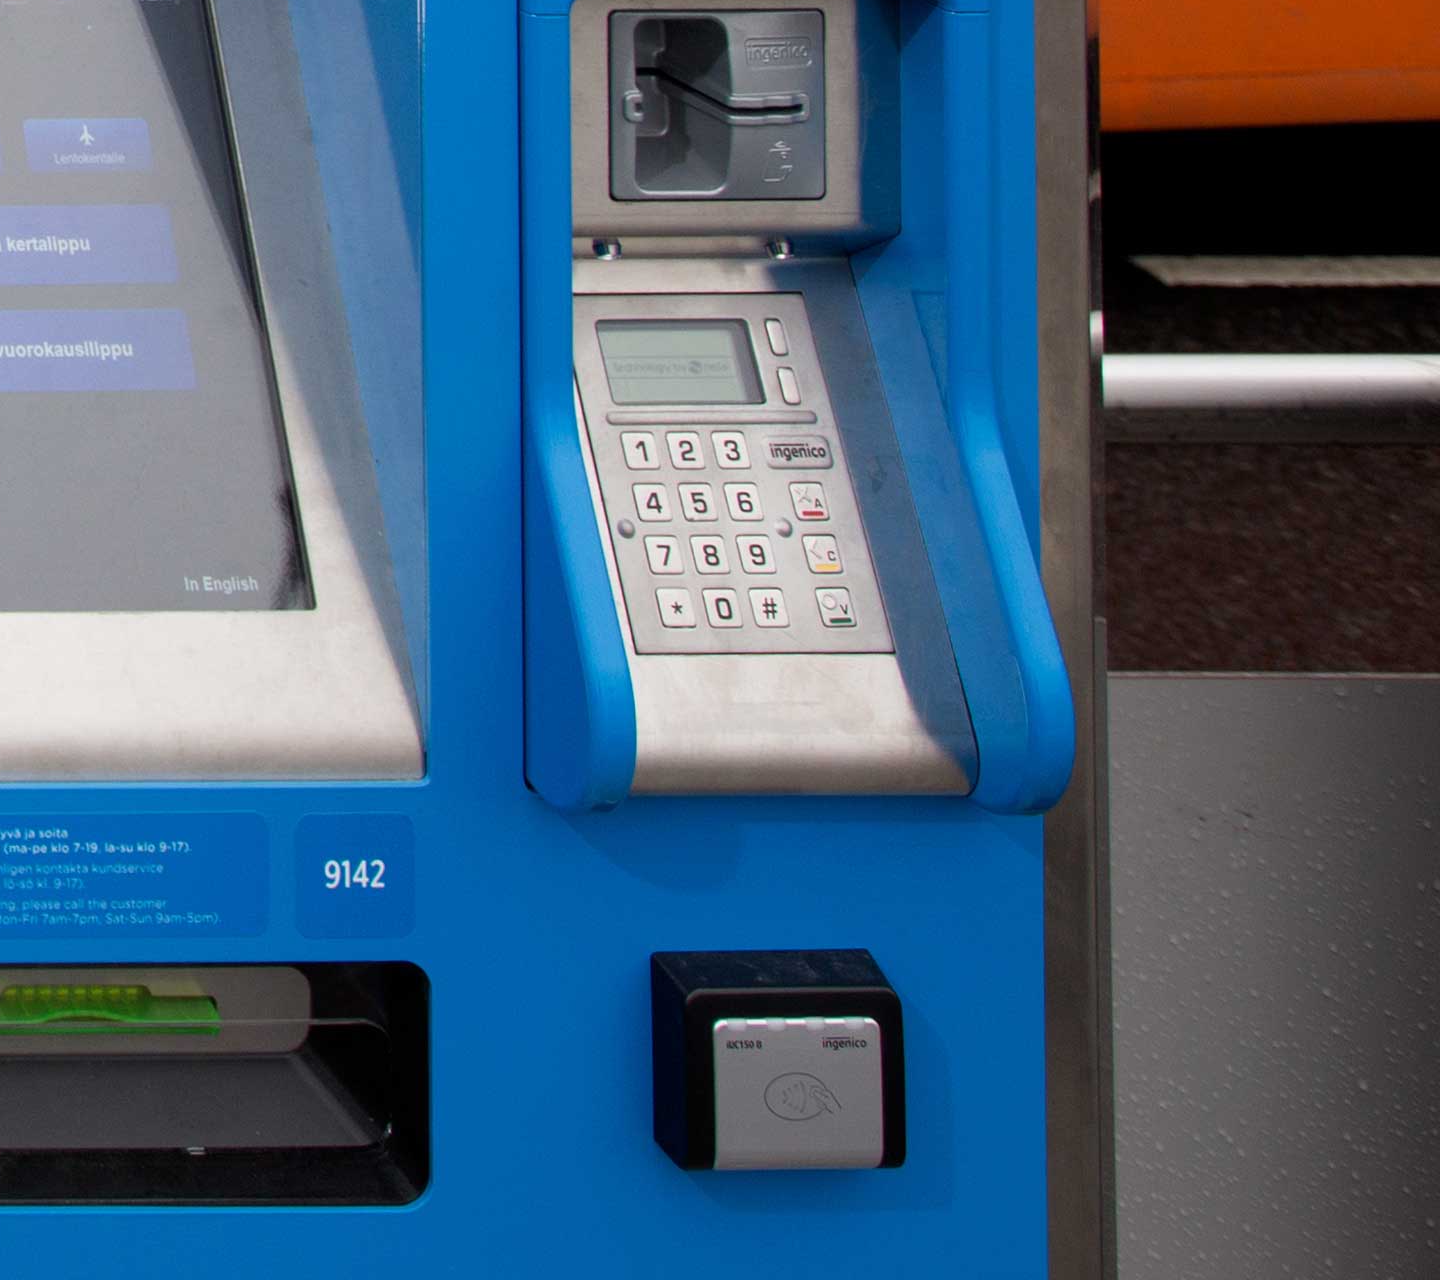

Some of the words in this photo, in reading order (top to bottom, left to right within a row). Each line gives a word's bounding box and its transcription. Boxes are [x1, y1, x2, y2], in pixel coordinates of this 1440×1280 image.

[6, 236, 91, 255] kertalippu
[635, 440, 649, 462] 1
[679, 440, 696, 461] 2
[723, 440, 741, 461] 3
[769, 443, 827, 461] ingenico
[646, 492, 663, 513] 4
[690, 492, 708, 513] 5
[737, 492, 753, 513] 6
[814, 498, 824, 508] A
[656, 544, 671, 566] 7
[702, 544, 720, 566] 8
[749, 544, 766, 566] 9
[827, 551, 837, 561] C
[184, 577, 199, 591] In
[203, 576, 259, 594] English
[715, 597, 733, 620] 0
[25, 828, 35, 840] ja
[39, 827, 68, 839] soita
[52, 841, 69, 853] klo
[105, 841, 133, 853] la-su
[137, 841, 155, 853] klo
[324, 859, 386, 890] 9142
[23, 899, 60, 911] please
[64, 898, 84, 910] call
[88, 898, 107, 910] the
[111, 898, 166, 910] customer
[822, 1037, 867, 1050] ingenico
